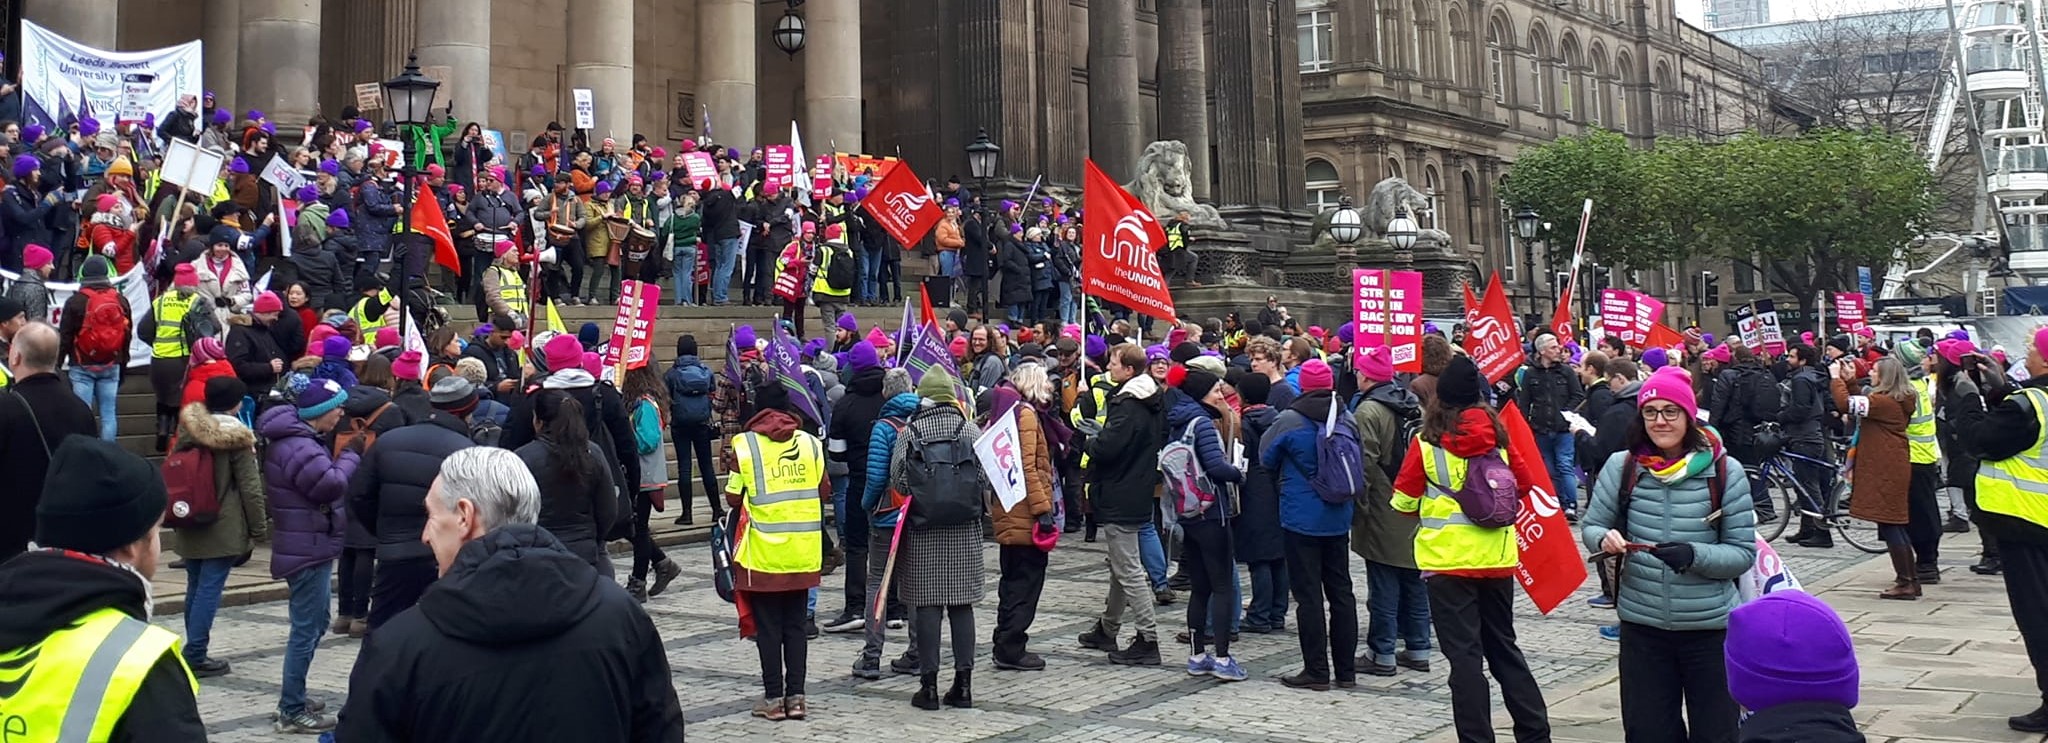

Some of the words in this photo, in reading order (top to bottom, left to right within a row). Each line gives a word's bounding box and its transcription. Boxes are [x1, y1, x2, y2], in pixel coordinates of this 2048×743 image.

[70, 52, 106, 67] Leeds
[58, 61, 116, 84] University
[884, 191, 915, 225] unite
[1100, 233, 1160, 277] unite
[1359, 275, 1378, 286] ON
[1359, 287, 1405, 299] STRKE
[1359, 299, 1377, 310] TO
[1395, 313, 1416, 323] MY
[1359, 323, 1415, 335] PENION
